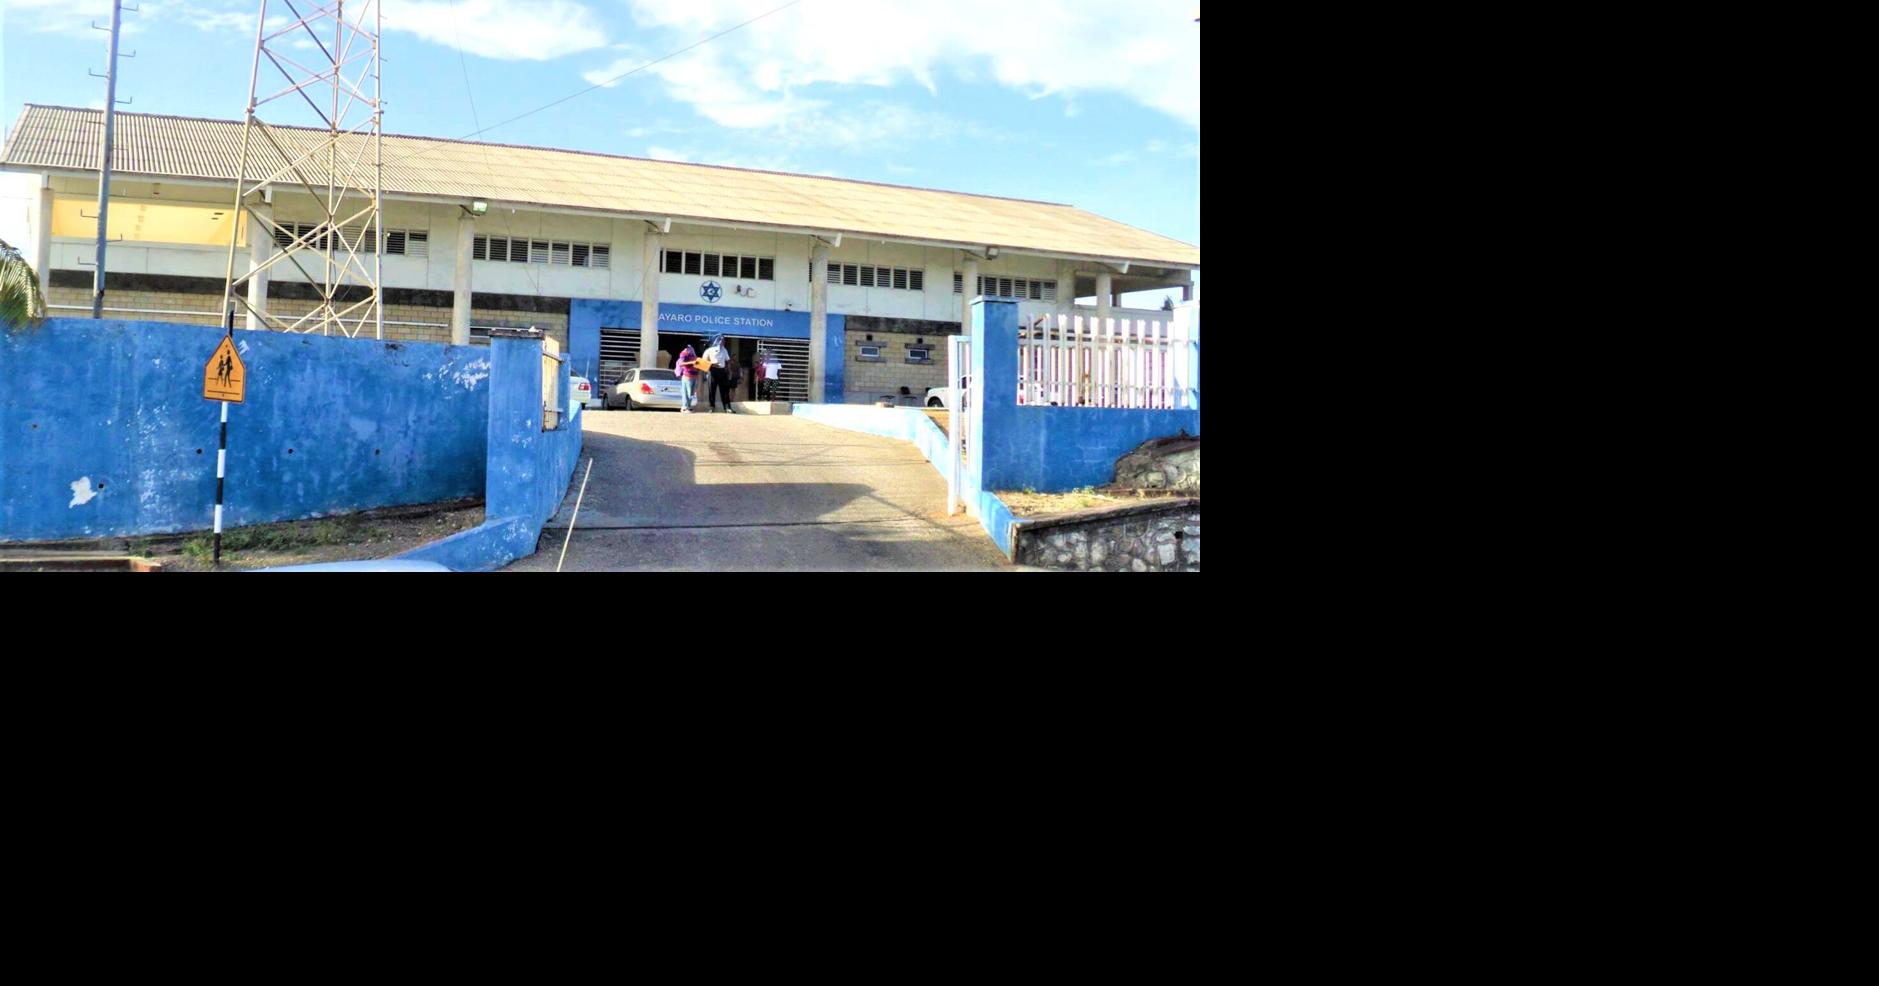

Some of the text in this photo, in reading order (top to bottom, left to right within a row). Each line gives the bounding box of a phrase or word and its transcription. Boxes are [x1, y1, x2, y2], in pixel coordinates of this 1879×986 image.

[657, 312, 774, 327] AYARO POLICE STATION
